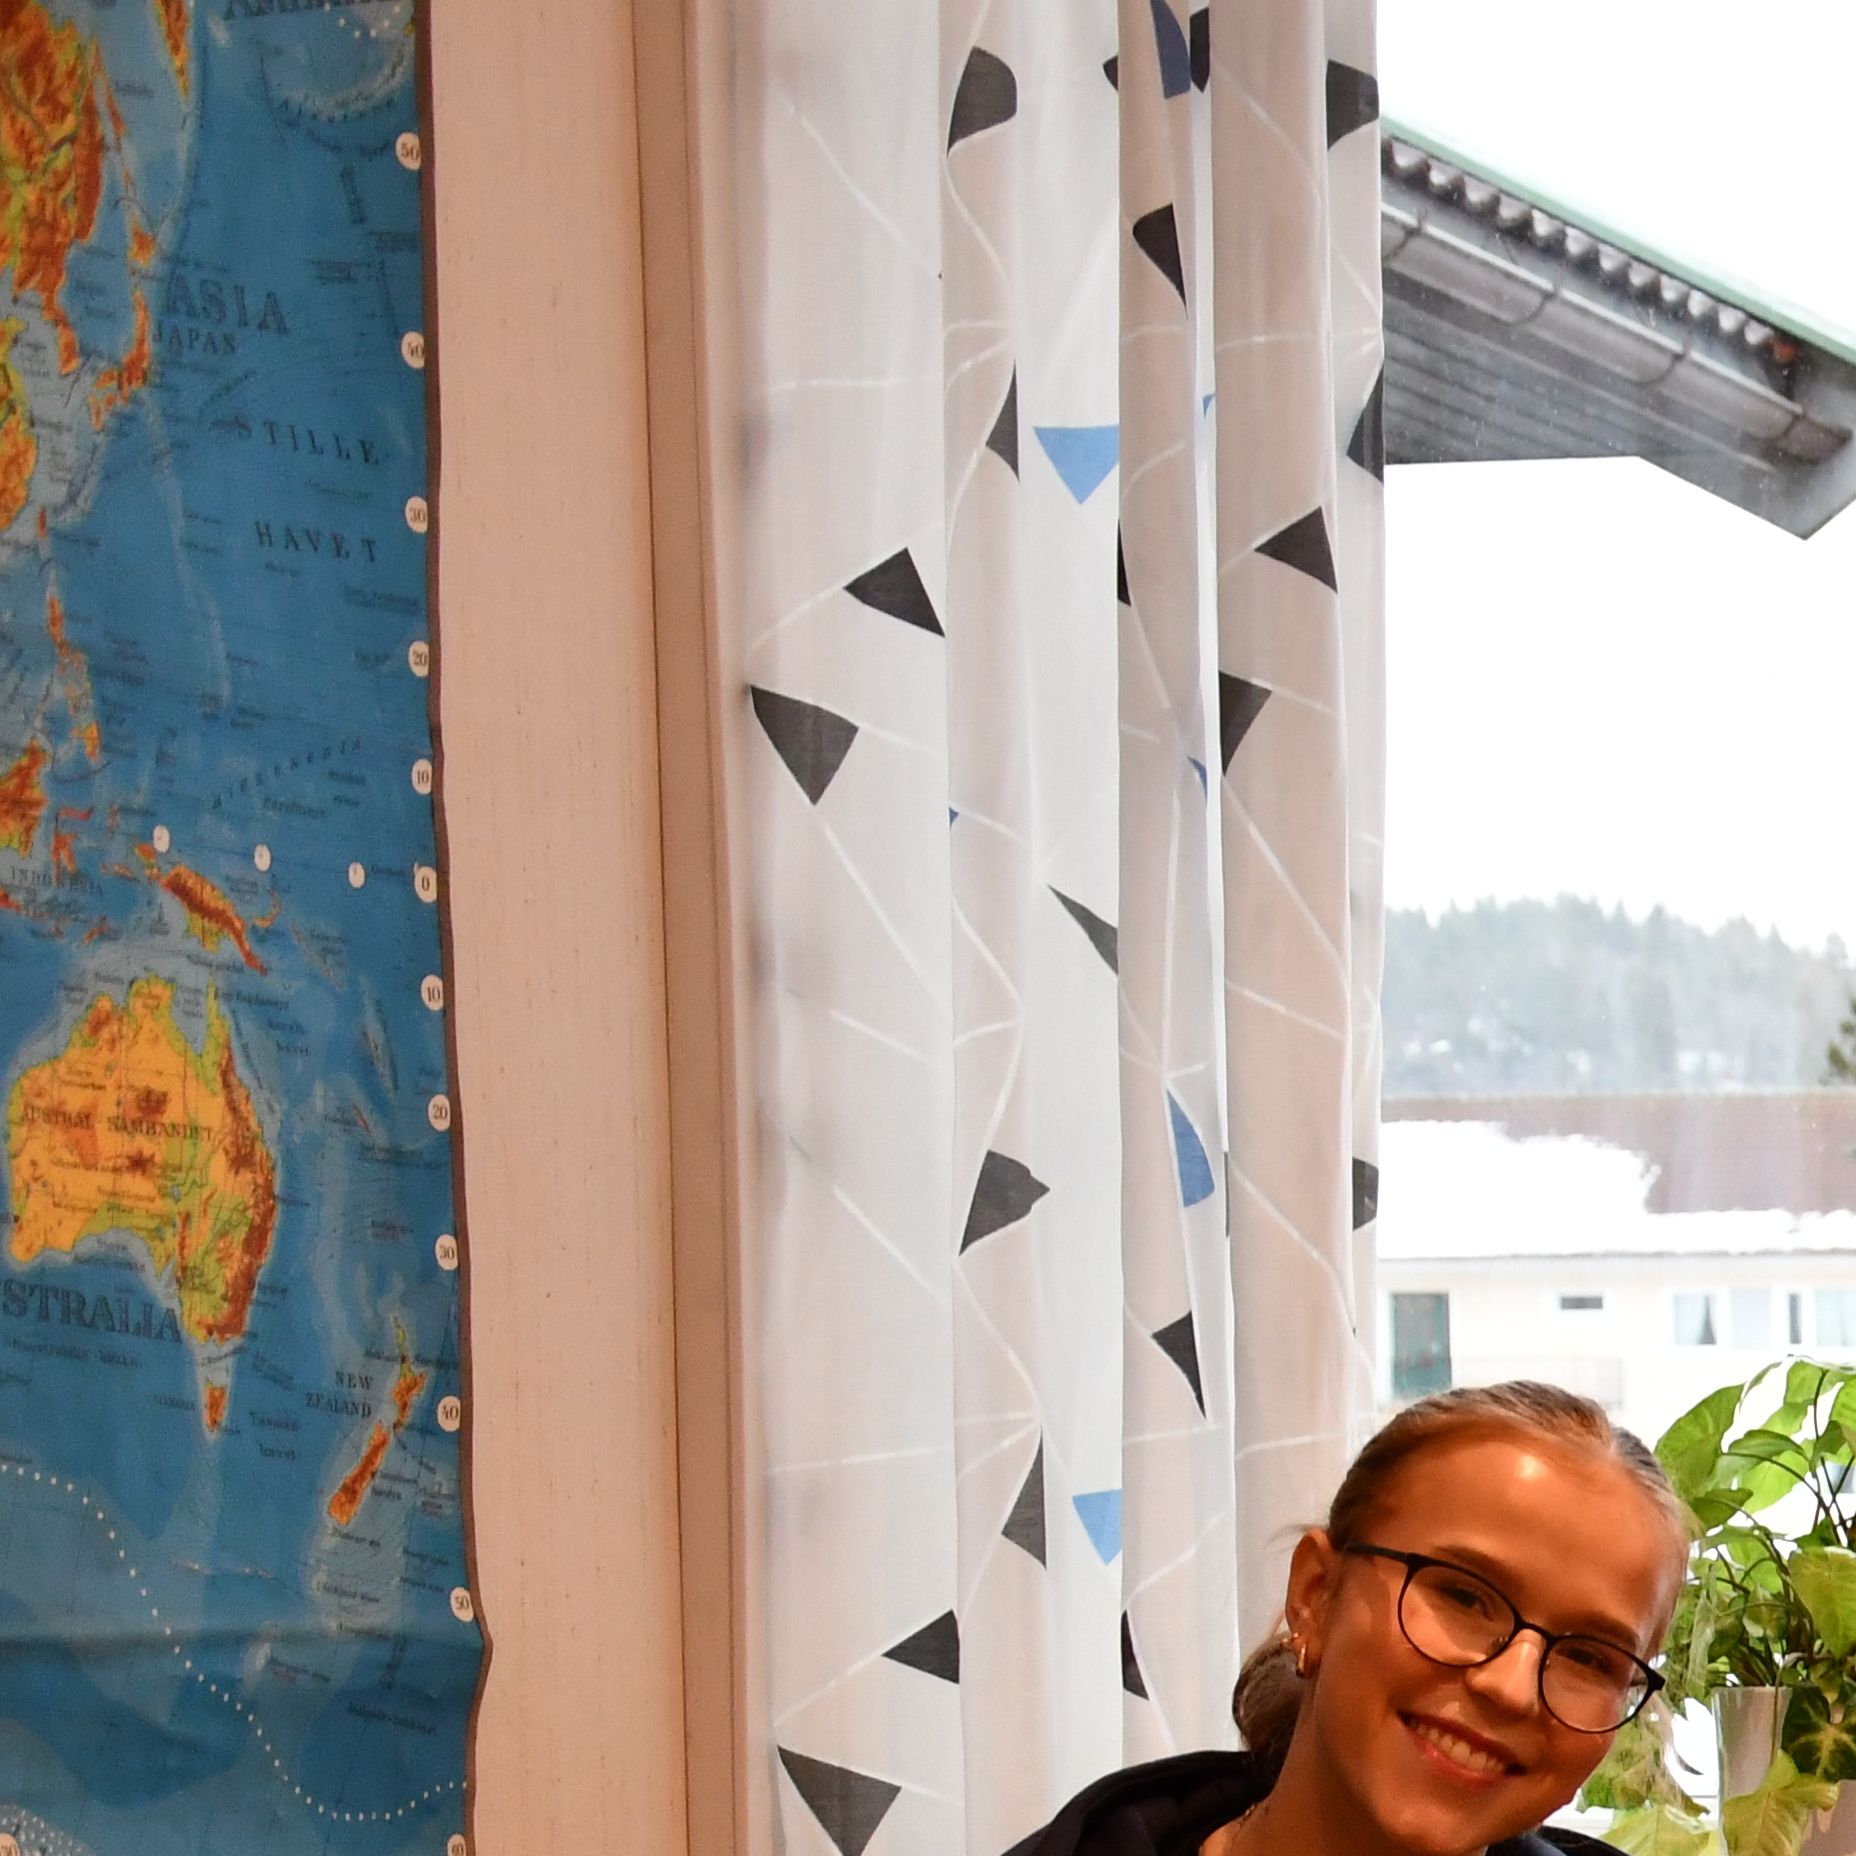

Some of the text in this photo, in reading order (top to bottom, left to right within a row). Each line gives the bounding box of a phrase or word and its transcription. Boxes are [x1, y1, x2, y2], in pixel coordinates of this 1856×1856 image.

[401, 142, 420, 160] 50
[166, 269, 289, 335] ASIA
[153, 323, 235, 355] JAPAN
[234, 412, 381, 466] STILLE
[253, 520, 377, 563] HAVET
[411, 650, 428, 667] 20
[415, 769, 430, 786] 10
[420, 875, 431, 892] 0
[427, 986, 442, 1002] 10
[431, 1104, 448, 1121] 20
[438, 1243, 456, 1261] 30
[334, 1370, 374, 1391] NEW
[306, 1392, 373, 1420] ZEALAND
